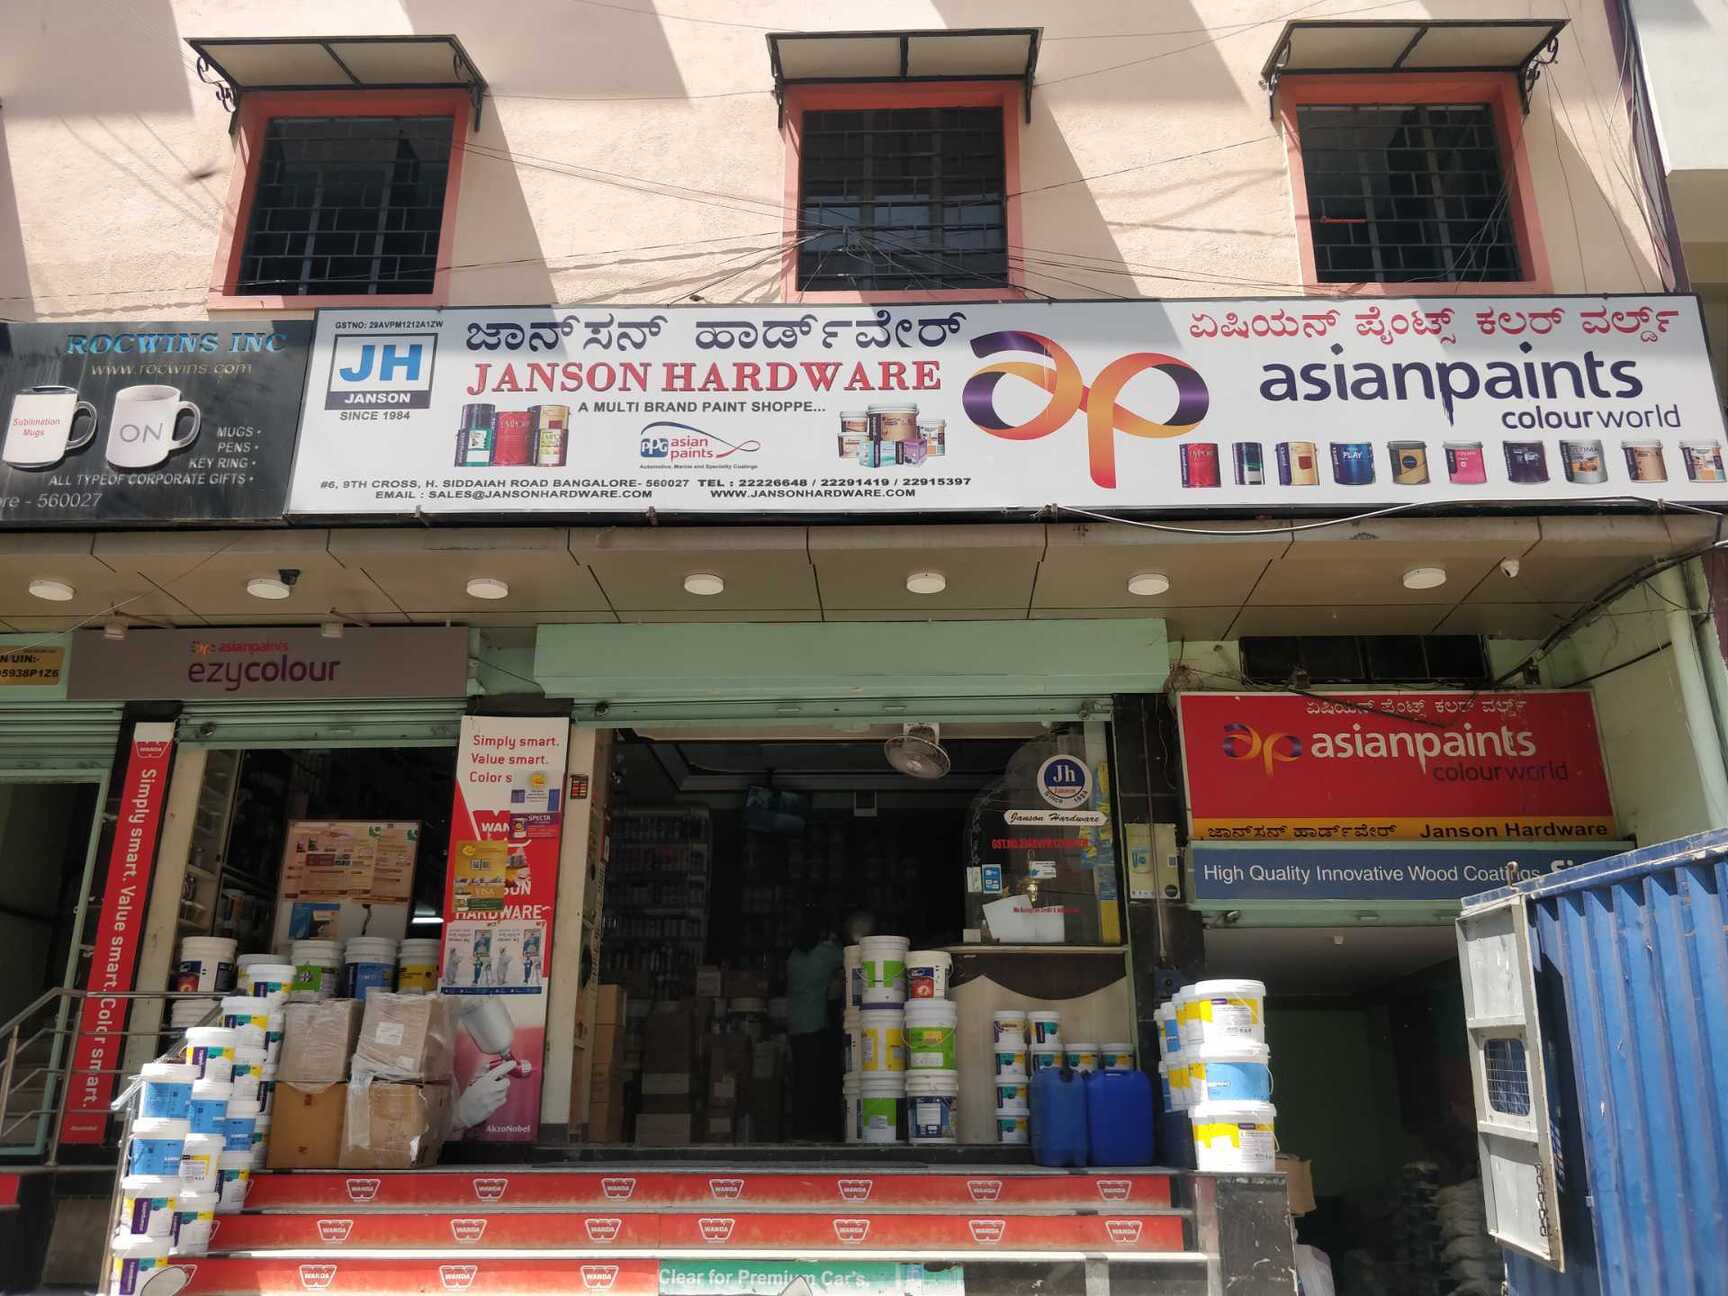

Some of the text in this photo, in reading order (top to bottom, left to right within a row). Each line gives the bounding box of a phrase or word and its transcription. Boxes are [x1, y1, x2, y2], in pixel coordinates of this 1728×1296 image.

[1475, 306, 1566, 336] ಕಲರ್
[66, 331, 289, 355] ROCWINS INC
[91, 360, 253, 377] www.rocwins.com
[339, 343, 423, 383] JH
[466, 359, 941, 396] JANSON HARDWARE
[1259, 342, 1644, 427] asianpaints
[344, 392, 412, 404] JANSON
[577, 401, 826, 413] A MULTI BRAND PAINT SHOPPE...
[339, 410, 411, 421] SINCE 1984
[23, 429, 45, 438] Mugs
[119, 422, 164, 444] ON
[216, 426, 254, 438] MUGS
[217, 441, 252, 454] PENS
[641, 438, 668, 455] PPG
[671, 435, 708, 447] asian
[671, 447, 713, 462] paints
[188, 457, 249, 469] KEY RING
[48, 474, 72, 486] ALL
[128, 472, 206, 486] CORPORATE
[209, 472, 247, 485] GIFTS
[342, 480, 368, 489] 9TH
[371, 479, 422, 490] CROSS,
[425, 479, 438, 488] H.
[442, 479, 506, 488] SIDDAIAH
[511, 479, 549, 488] ROAD
[645, 479, 690, 488] 560027
[697, 479, 726, 487] TEL
[738, 478, 808, 487] 22226648
[820, 478, 890, 487] 22291419
[902, 477, 972, 486] 22915397
[37, 492, 103, 508] 560027
[375, 490, 416, 499] EMAIL
[428, 489, 653, 500] SALES@JANSONHARDWARE.COM
[710, 488, 916, 498] WWW.JANSONHARDWARE.COM
[188, 654, 341, 692] ezycolour
[472, 734, 560, 750] Simply smart.
[1311, 722, 1537, 775] asianpaints
[471, 752, 549, 765] Value smart.
[469, 771, 502, 783] Color
[1052, 764, 1076, 783] Jh
[128, 768, 157, 824] Simply
[1008, 811, 1044, 822] Janson
[481, 822, 511, 833] WAN
[1419, 821, 1608, 839] Janson Hardware
[121, 827, 144, 883] smart.
[1203, 864, 1244, 885] High
[1249, 864, 1311, 886] Quality
[1316, 865, 1404, 882] Innovative
[1407, 865, 1458, 882] Wood
[113, 885, 137, 931] Value
[103, 935, 124, 993] smart.
[486, 1124, 531, 1134] AkzoNobel
[659, 1268, 703, 1286] Clear
[708, 1268, 733, 1285] for
